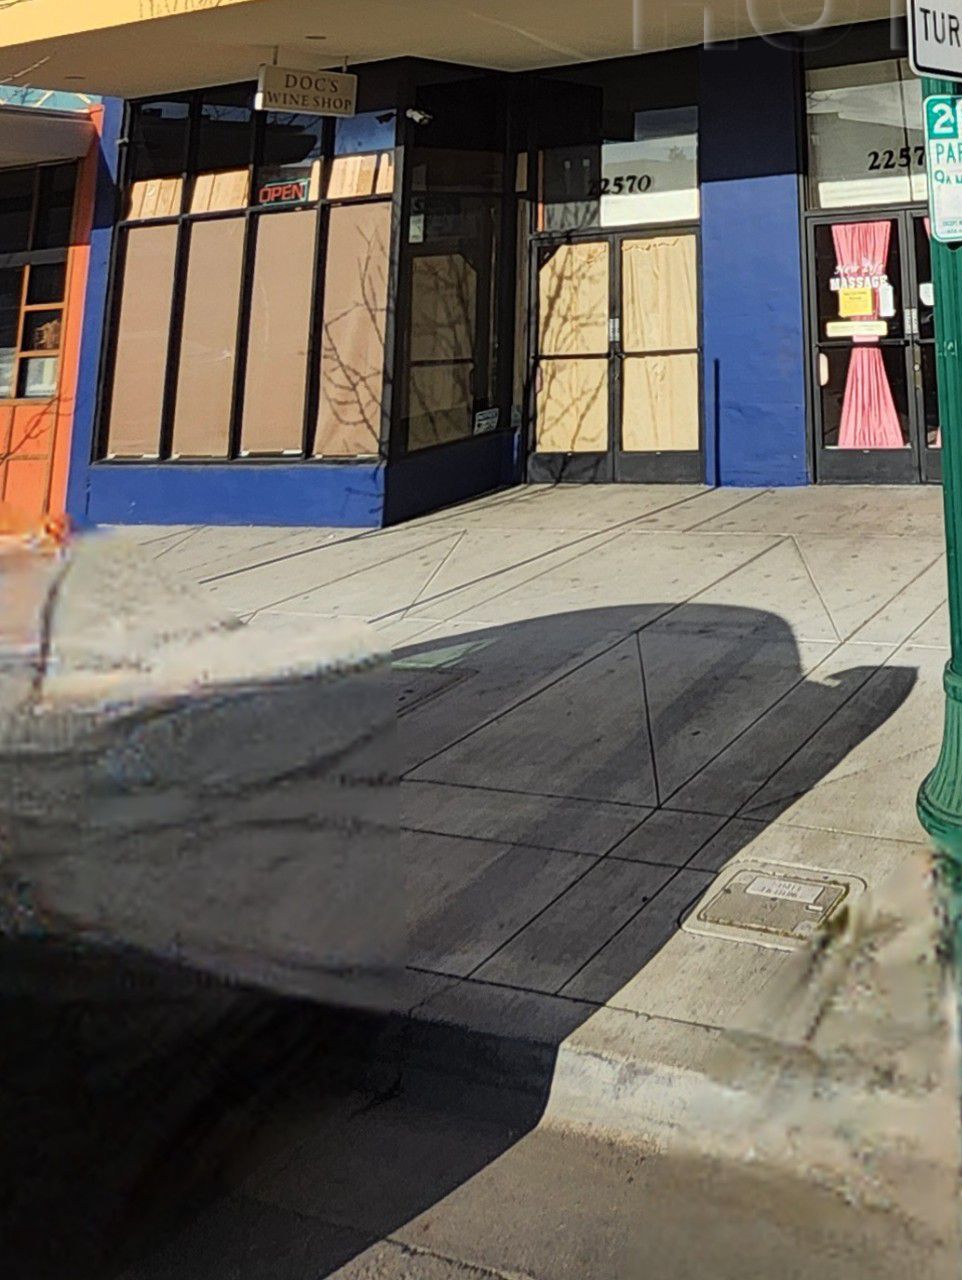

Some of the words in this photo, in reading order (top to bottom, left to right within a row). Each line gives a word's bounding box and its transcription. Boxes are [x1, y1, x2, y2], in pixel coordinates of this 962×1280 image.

[285, 74, 339, 93] DOC'S
[267, 91, 310, 107] WINE
[310, 97, 352, 111] SHOP
[932, 102, 955, 134] 2
[259, 184, 304, 203] OPEN
[830, 274, 888, 290] MASSAGE
